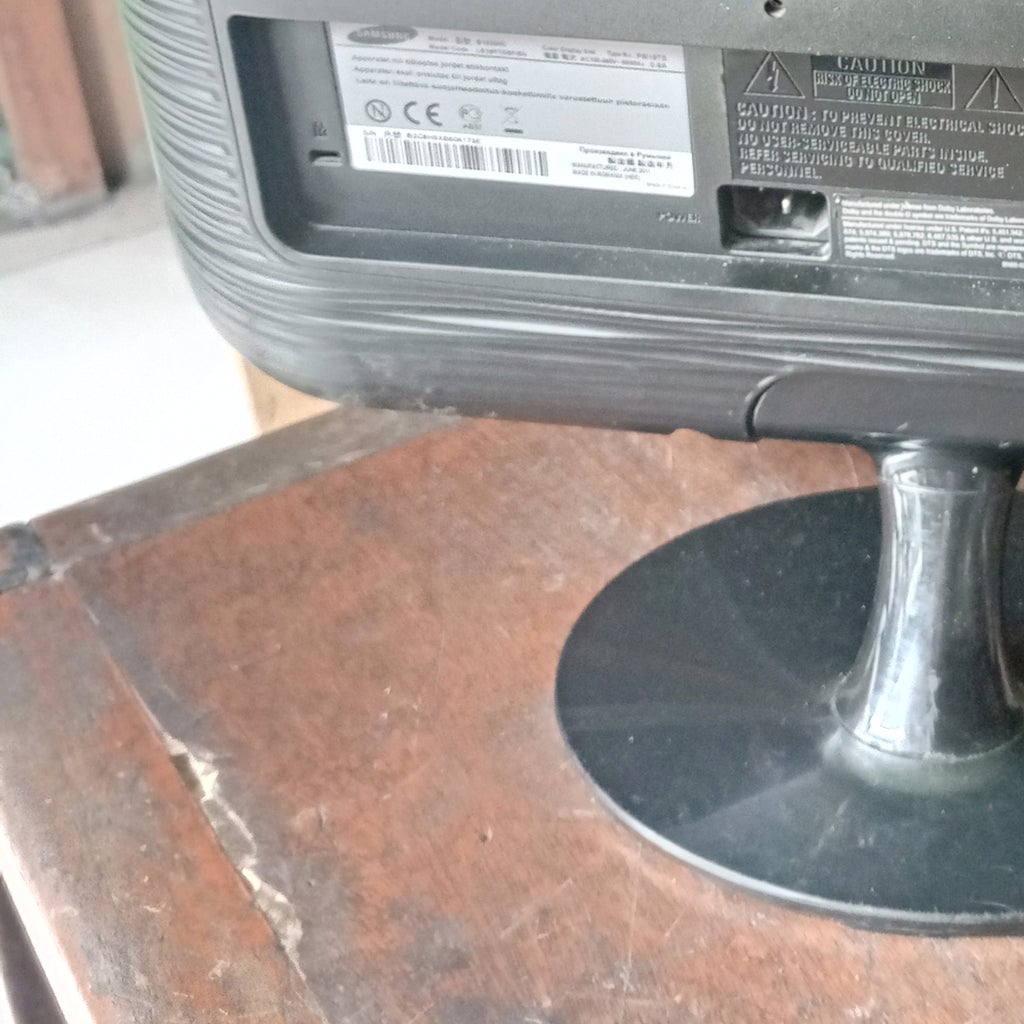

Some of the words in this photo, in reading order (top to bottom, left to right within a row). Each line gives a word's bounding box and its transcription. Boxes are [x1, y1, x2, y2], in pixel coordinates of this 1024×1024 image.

[837, 56, 925, 75] CAUTION
[816, 73, 842, 86] RISK
[845, 74, 858, 87] OF
[860, 75, 911, 91] ELECTRIC
[914, 78, 951, 94] SHOCK
[848, 88, 862, 100] DO
[865, 89, 888, 103] NOT
[892, 91, 921, 105] OPEN
[737, 102, 808, 120] CAUTION
[822, 110, 838, 122] TO
[841, 112, 902, 127] PREVENT
[906, 116, 985, 134] ELECTRICAL
[738, 119, 756, 132] DO
[760, 120, 787, 133] NOT
[790, 123, 847, 138] REMOVE
[851, 127, 880, 141] THIS
[885, 129, 931, 144] COVER.
[738, 134, 758, 147] NO
[762, 135, 890, 156] USER-SERVICEABLE
[893, 145, 935, 160] PARTS
[940, 148, 988, 163] INSIDE.
[739, 148, 779, 162] REFER
[782, 150, 853, 168] SERVICING
[858, 156, 873, 169] TO
[877, 158, 946, 175] QUALIFIED
[950, 163, 1005, 179] SERVICE
[740, 162, 822, 180] PERSONNEL.
